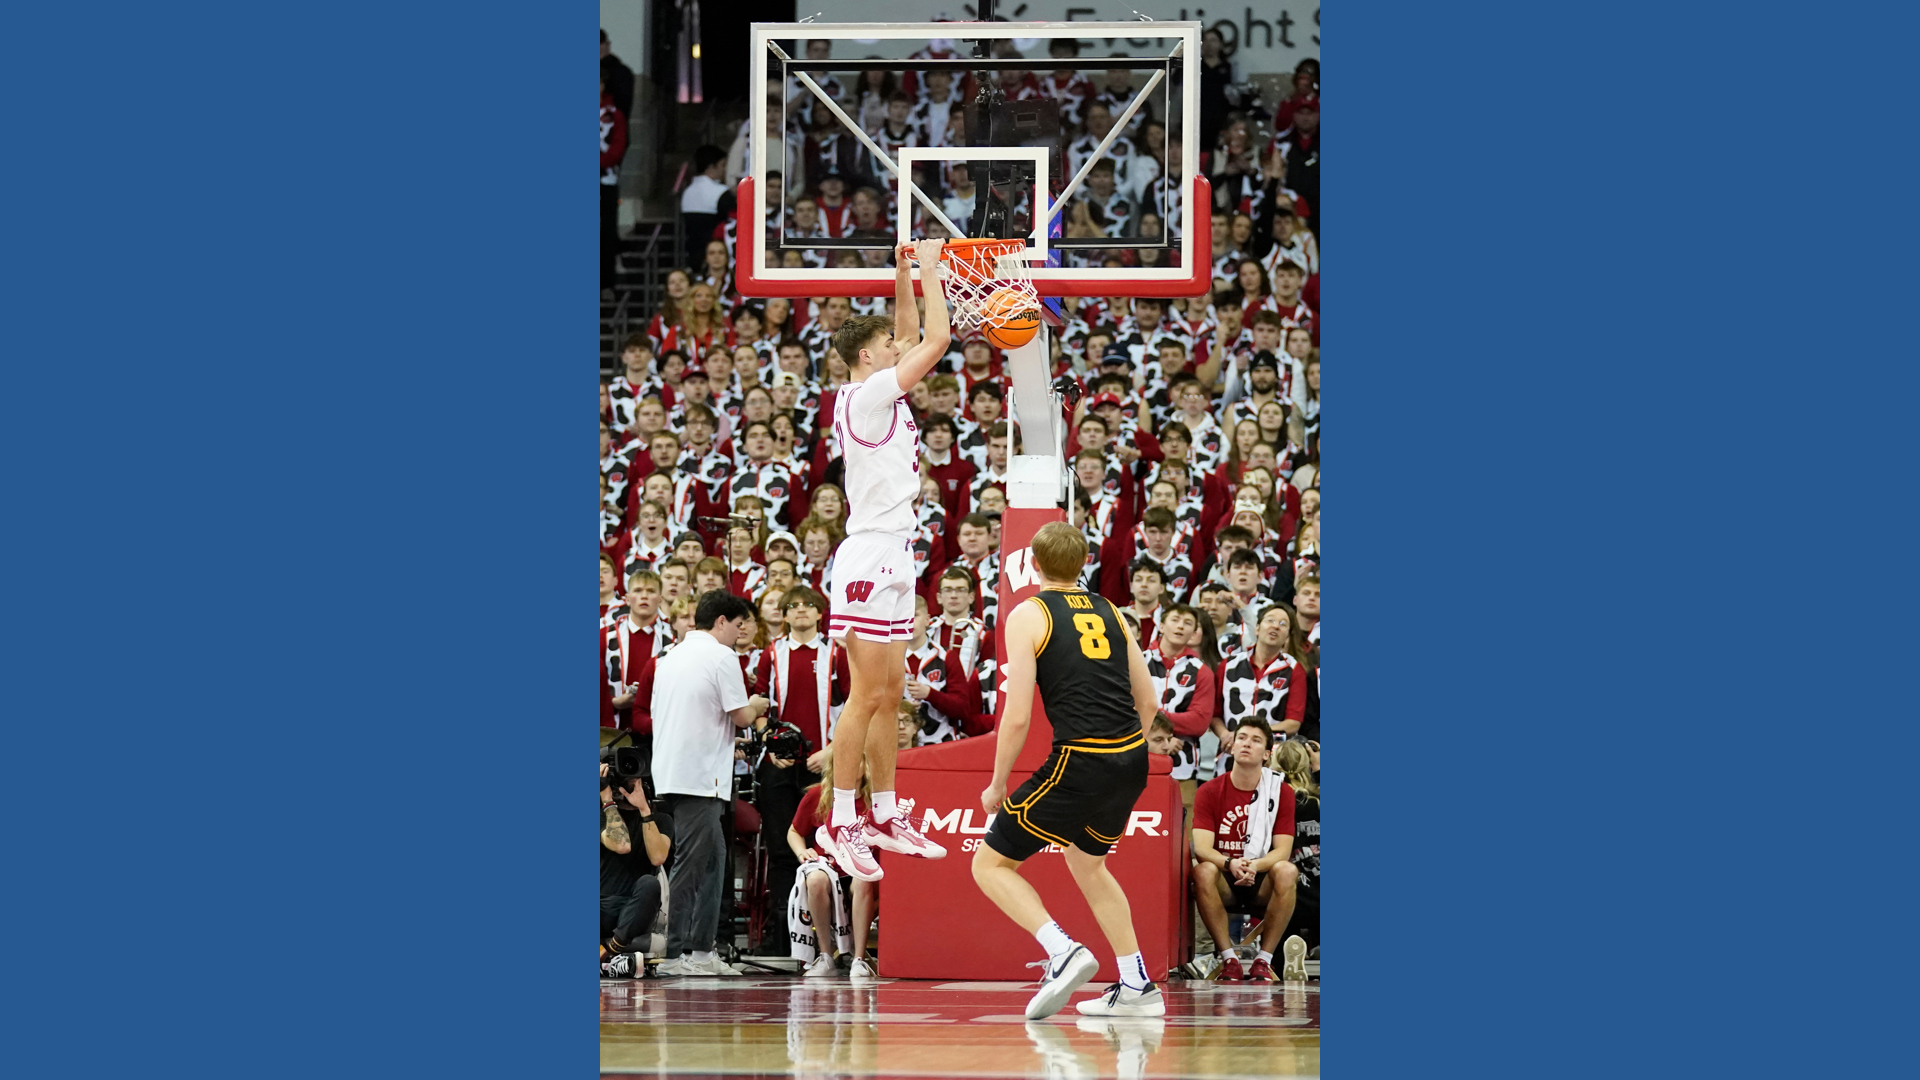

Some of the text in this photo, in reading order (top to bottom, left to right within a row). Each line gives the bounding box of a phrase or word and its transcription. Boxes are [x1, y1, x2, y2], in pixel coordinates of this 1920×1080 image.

[845, 580, 874, 604] W
[1063, 595, 1093, 609] KOCH
[1072, 613, 1111, 659] 8
[927, 668, 941, 683] W
